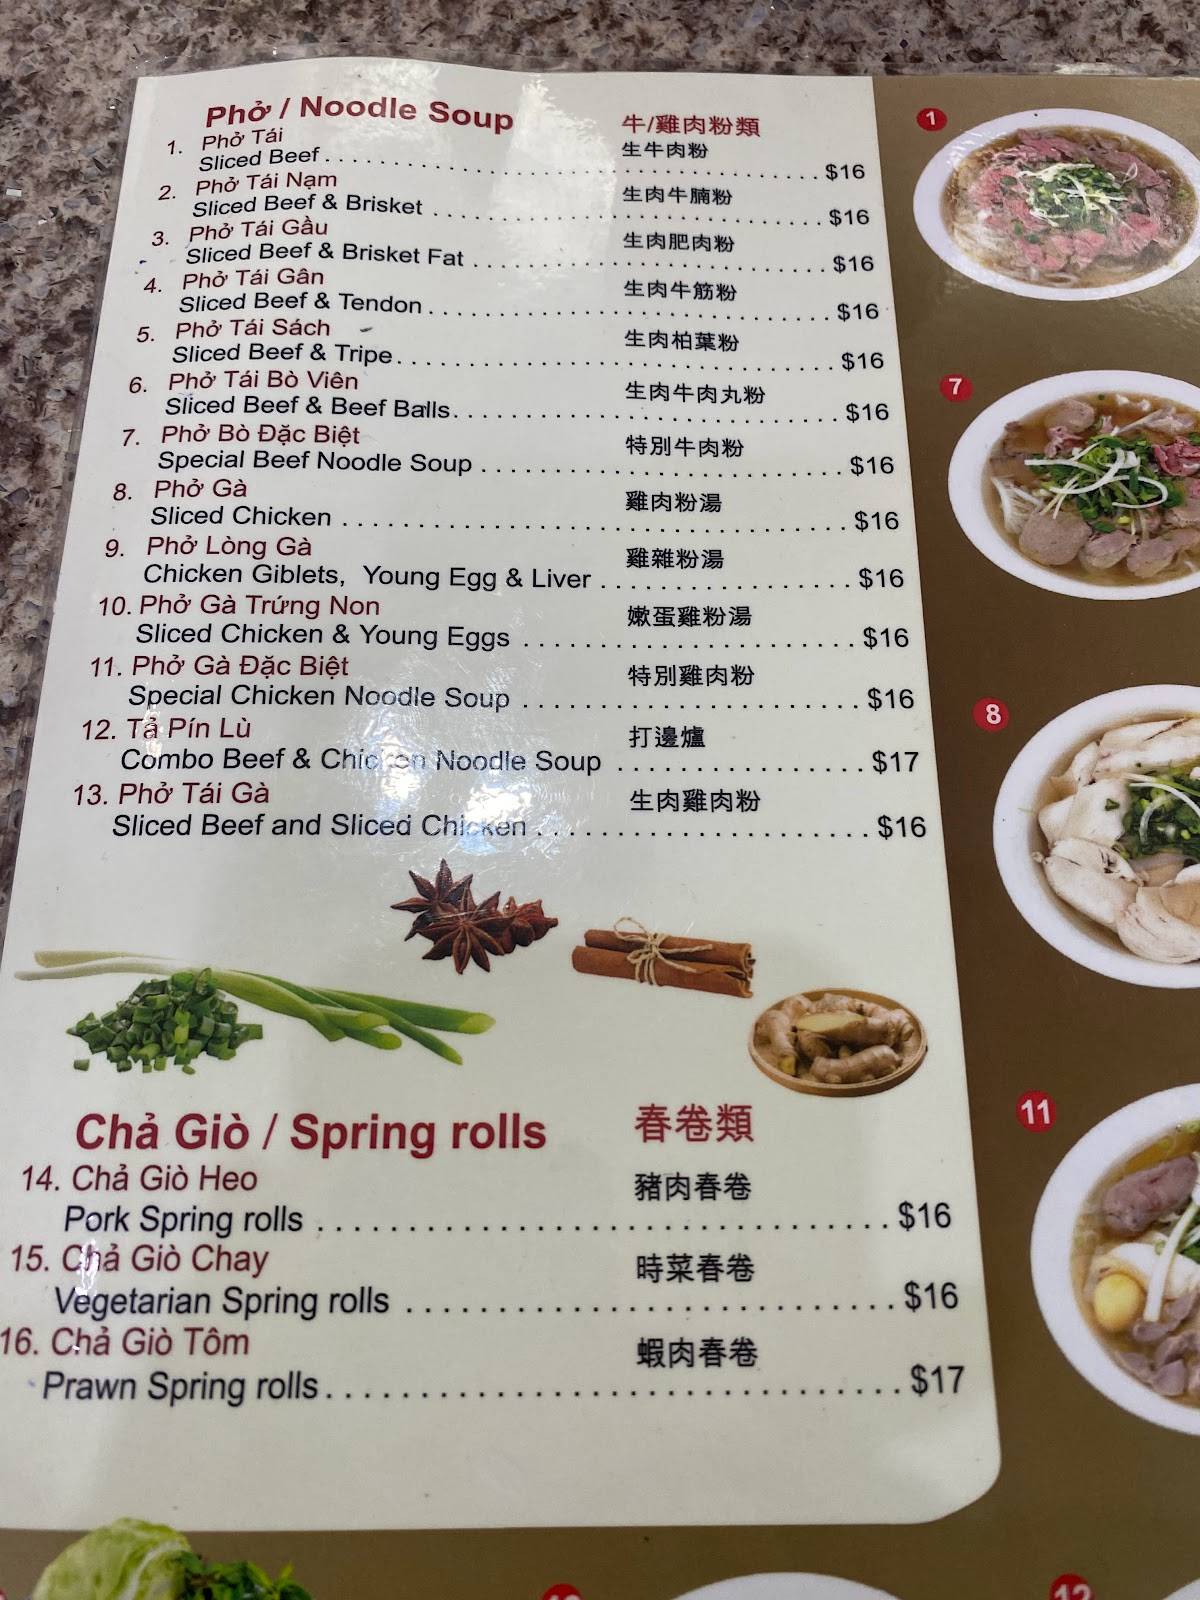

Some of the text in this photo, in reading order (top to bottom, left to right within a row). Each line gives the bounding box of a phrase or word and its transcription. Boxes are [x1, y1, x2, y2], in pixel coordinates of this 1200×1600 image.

[206, 96, 513, 135] Phở Noodle Soup
[621, 113, 760, 137] 牛/雞肉粉類
[925, 112, 937, 126] 1
[168, 127, 283, 155] 1. Phở Tái
[621, 141, 709, 159] 生牛肉粉
[199, 146, 320, 172] Sliced Beef
[825, 162, 865, 182] $16
[158, 171, 337, 200] 2. Phở Tái Nạm
[622, 185, 733, 206] 生肉牛腩粉
[346, 194, 423, 215] Brisket
[829, 208, 870, 227] $16
[152, 215, 328, 246] 3. Phở Tái Gầu
[623, 231, 735, 253] 生肉肥肉粉
[343, 243, 464, 267] Brisket Fat
[833, 254, 874, 274] $16
[144, 268, 324, 293] 4. Phở Tái Gân
[624, 278, 737, 302] 生肉牛筋粉
[338, 292, 421, 314] Tendon
[837, 302, 879, 323] $16
[136, 318, 330, 343] 5. Phở Tái Sách
[334, 344, 392, 367] Tripe
[841, 351, 884, 372] $16
[129, 370, 358, 394] 6. Phở Tái Bò Viên
[625, 379, 766, 405] 生肉牛肉丸粉
[948, 378, 962, 396] 7
[394, 399, 450, 419] Balls
[846, 402, 889, 423] $16
[123, 424, 360, 447] 7. Phở Bò Đặc Biệt
[625, 434, 744, 458] 特別牛肉粉
[158, 450, 472, 477] Special Beef Noodle Soup
[850, 455, 894, 477] $16
[113, 478, 247, 501] 8. Phở Gà
[625, 490, 722, 513] 雞肉粉湯
[151, 505, 331, 526] Sliced Chicken
[855, 510, 899, 533] $16
[104, 535, 311, 560] 9. Phở Lòng Gà
[625, 546, 724, 570] 雞雜粉湯
[144, 563, 591, 592] Chicken Giblets, Young Egg Liver
[859, 567, 904, 590] $16
[99, 593, 379, 620] 10. Phở Gà Trứng Non
[221, 623, 510, 652] Chicken Young Eggs
[863, 626, 909, 650] $16
[91, 654, 349, 680] 11. Phở Gà Đặc Biệt
[627, 664, 755, 688] 特別雞肉粉
[129, 684, 510, 713] Special Chicken Noodle Soup
[867, 687, 914, 711] $16
[985, 705, 1001, 724] 8
[83, 717, 251, 740] 12. Pín Lù
[121, 748, 601, 776] Combo Beef Noodle Soup
[872, 749, 919, 775] $17
[74, 781, 269, 806] 13. Phở Tái Gà
[630, 788, 762, 813] 生肉雞肉粉
[112, 813, 411, 837] Sliced Beef and Sliced
[877, 814, 927, 840] $16
[1020, 1101, 1051, 1124] 11
[76, 1112, 547, 1160] Chả Giò Spring rolls
[22, 1163, 258, 1192] 14. Chả Giò Heo
[64, 1205, 303, 1239] Pork Spring rolls
[898, 1200, 952, 1232] $16
[11, 1244, 270, 1279] 15. Giò Chay
[54, 1286, 389, 1322] Vegetarian Spring rolls
[904, 1280, 959, 1313] $16
[0, 1326, 250, 1356] 16. Chả Giò Tôm
[43, 1370, 319, 1408] Prawn Spring rolls
[910, 1363, 965, 1398] $17
